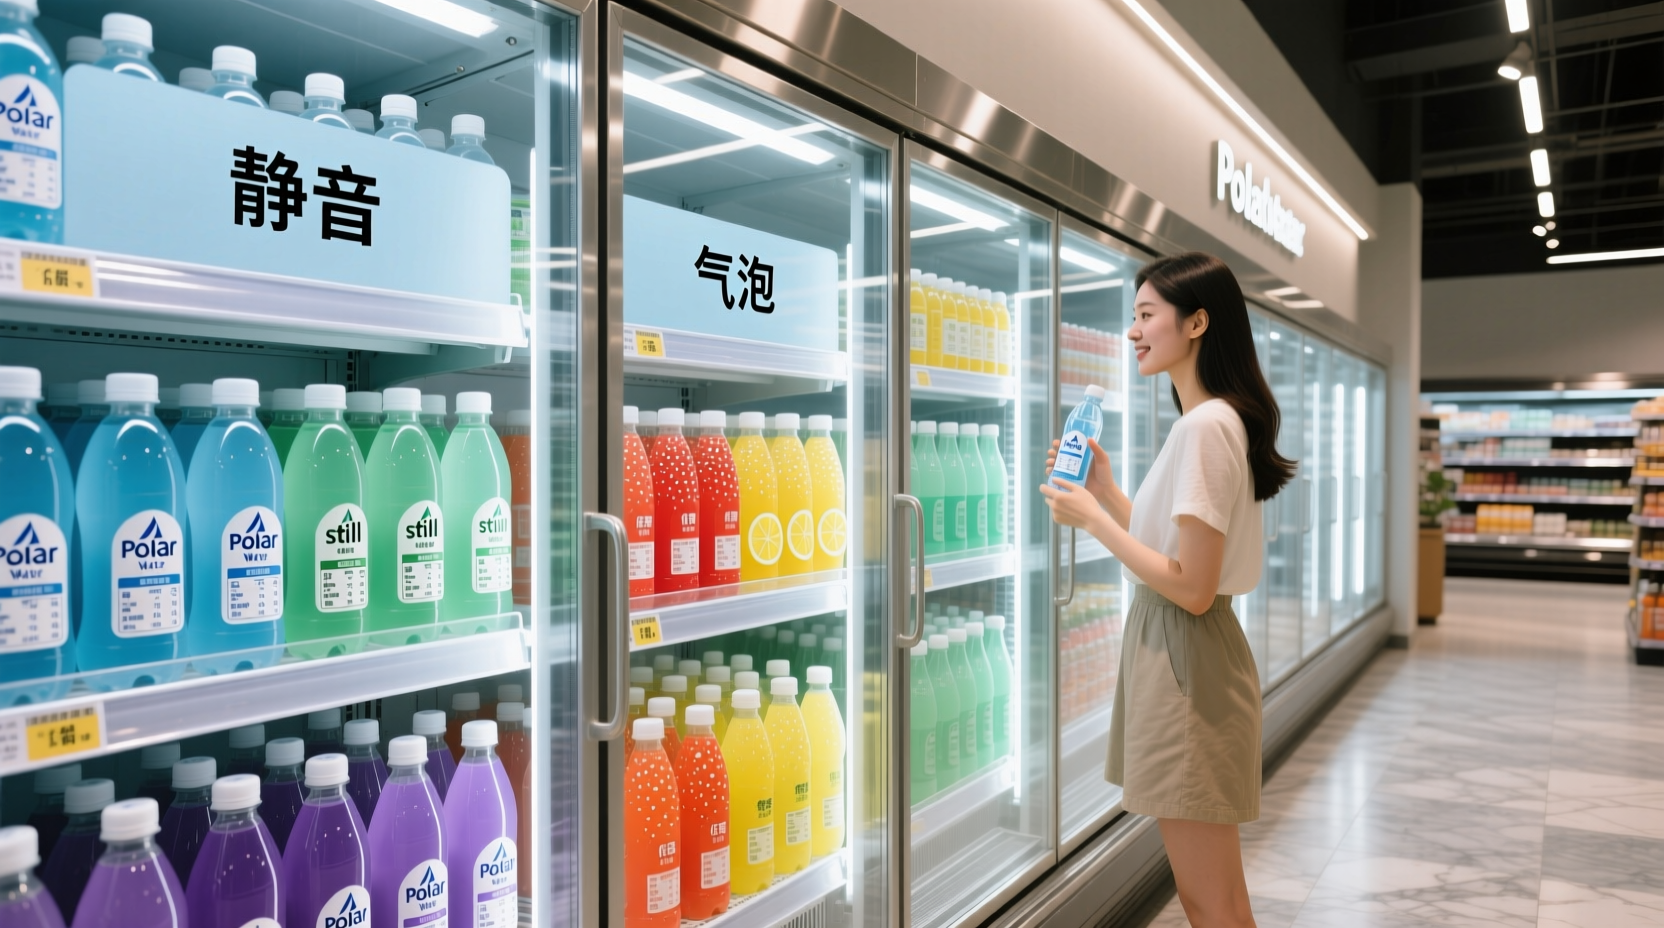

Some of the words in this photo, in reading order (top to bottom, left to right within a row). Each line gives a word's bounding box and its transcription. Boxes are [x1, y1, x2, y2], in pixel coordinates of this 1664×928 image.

[230, 145, 381, 247] 静音
[694, 244, 775, 314] 气泡
[326, 521, 361, 545] still
[406, 518, 438, 539] still
[122, 539, 178, 559] Polar
[229, 532, 278, 551] Polar
[480, 858, 516, 879] Polar
[406, 881, 446, 904] Polar
[325, 907, 367, 928] Polar
